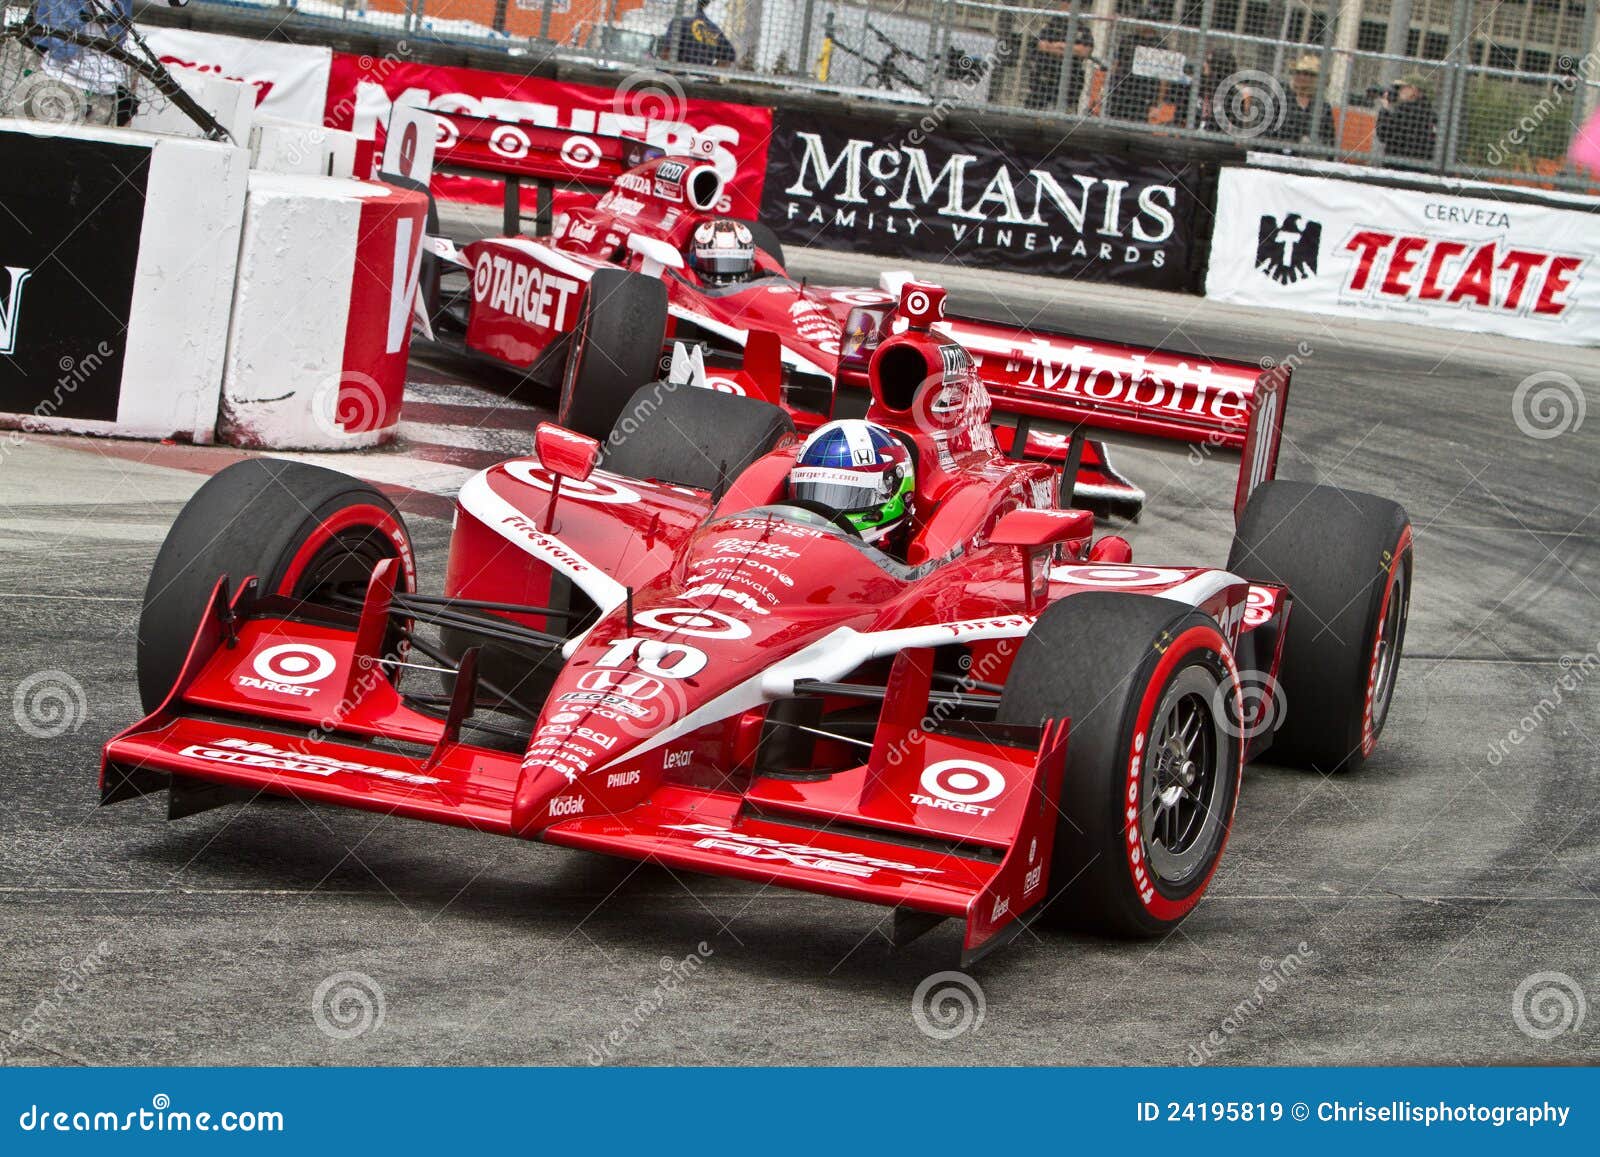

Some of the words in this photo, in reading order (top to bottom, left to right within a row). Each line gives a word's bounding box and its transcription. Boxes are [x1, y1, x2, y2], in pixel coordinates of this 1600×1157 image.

[1424, 203, 1511, 229] CERVEZA
[787, 202, 922, 235] FAMILY
[953, 223, 1166, 268] VINEYARDS
[1344, 230, 1585, 317] TECATE
[490, 255, 580, 333] TARGET
[1018, 338, 1248, 420] Mobile
[501, 516, 589, 573] Firestone
[715, 572, 781, 607] lifewater
[941, 615, 1034, 637] Firest
[594, 637, 709, 680] 10
[238, 675, 321, 697] TARGET
[663, 748, 694, 770] Lexar
[606, 769, 641, 789] PHILIPS
[549, 794, 586, 818] Kodak
[909, 793, 996, 817] TARGET
[694, 838, 881, 878] AXE
